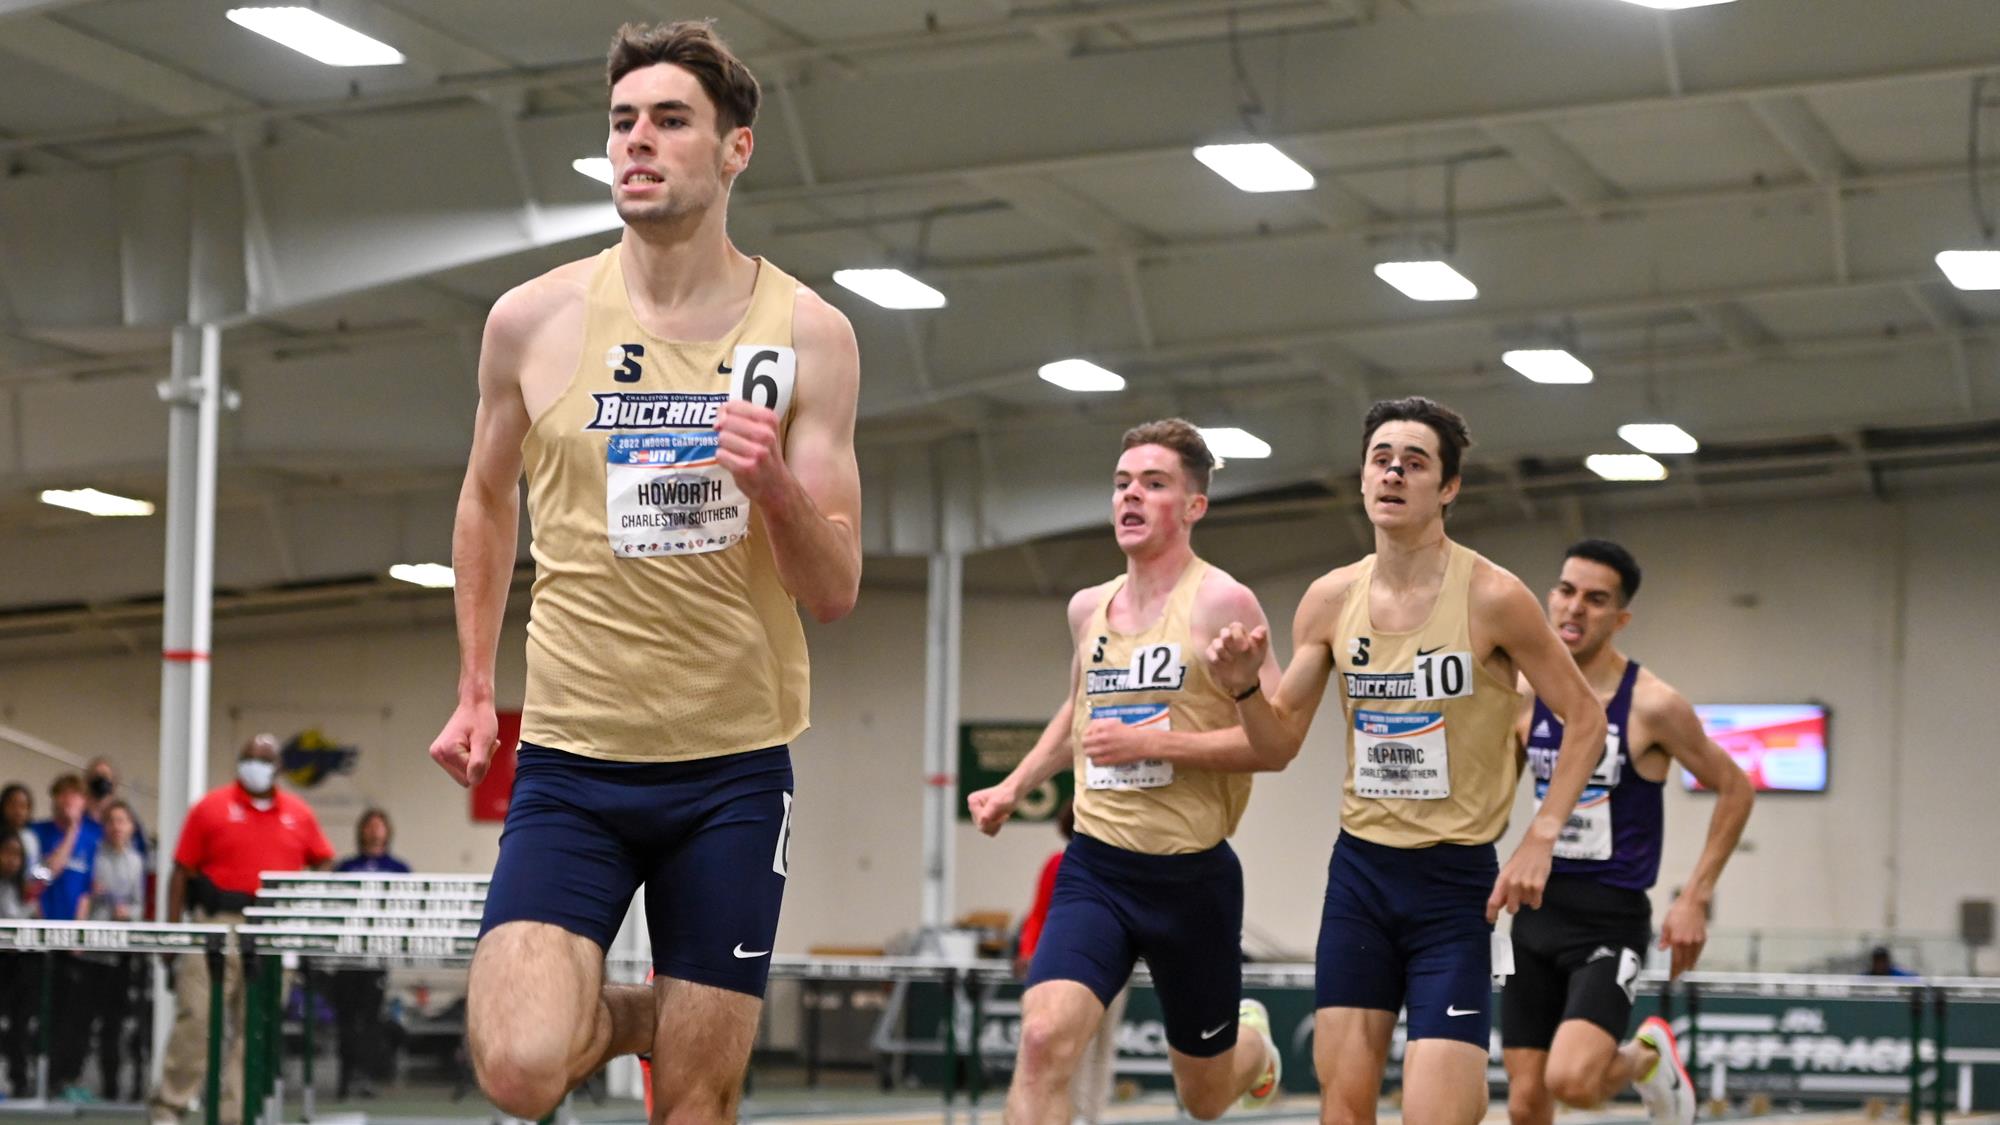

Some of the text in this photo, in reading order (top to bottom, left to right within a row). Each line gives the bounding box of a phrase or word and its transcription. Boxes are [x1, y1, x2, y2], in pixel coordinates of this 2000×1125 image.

[613, 344, 645, 383] S
[741, 350, 779, 410] 6
[596, 396, 719, 426] BUCCANE
[619, 436, 719, 449] 2022 INDOOR CHAMPIONS
[638, 480, 722, 506] HOWORTH
[621, 505, 739, 528] CHARLESTON SOUTHERN
[1138, 646, 1172, 685] 12
[1351, 637, 1371, 666] S
[1346, 674, 1417, 697] BUCCANE
[1418, 655, 1464, 698] 10
[1367, 747, 1425, 764] GILPATRIC
